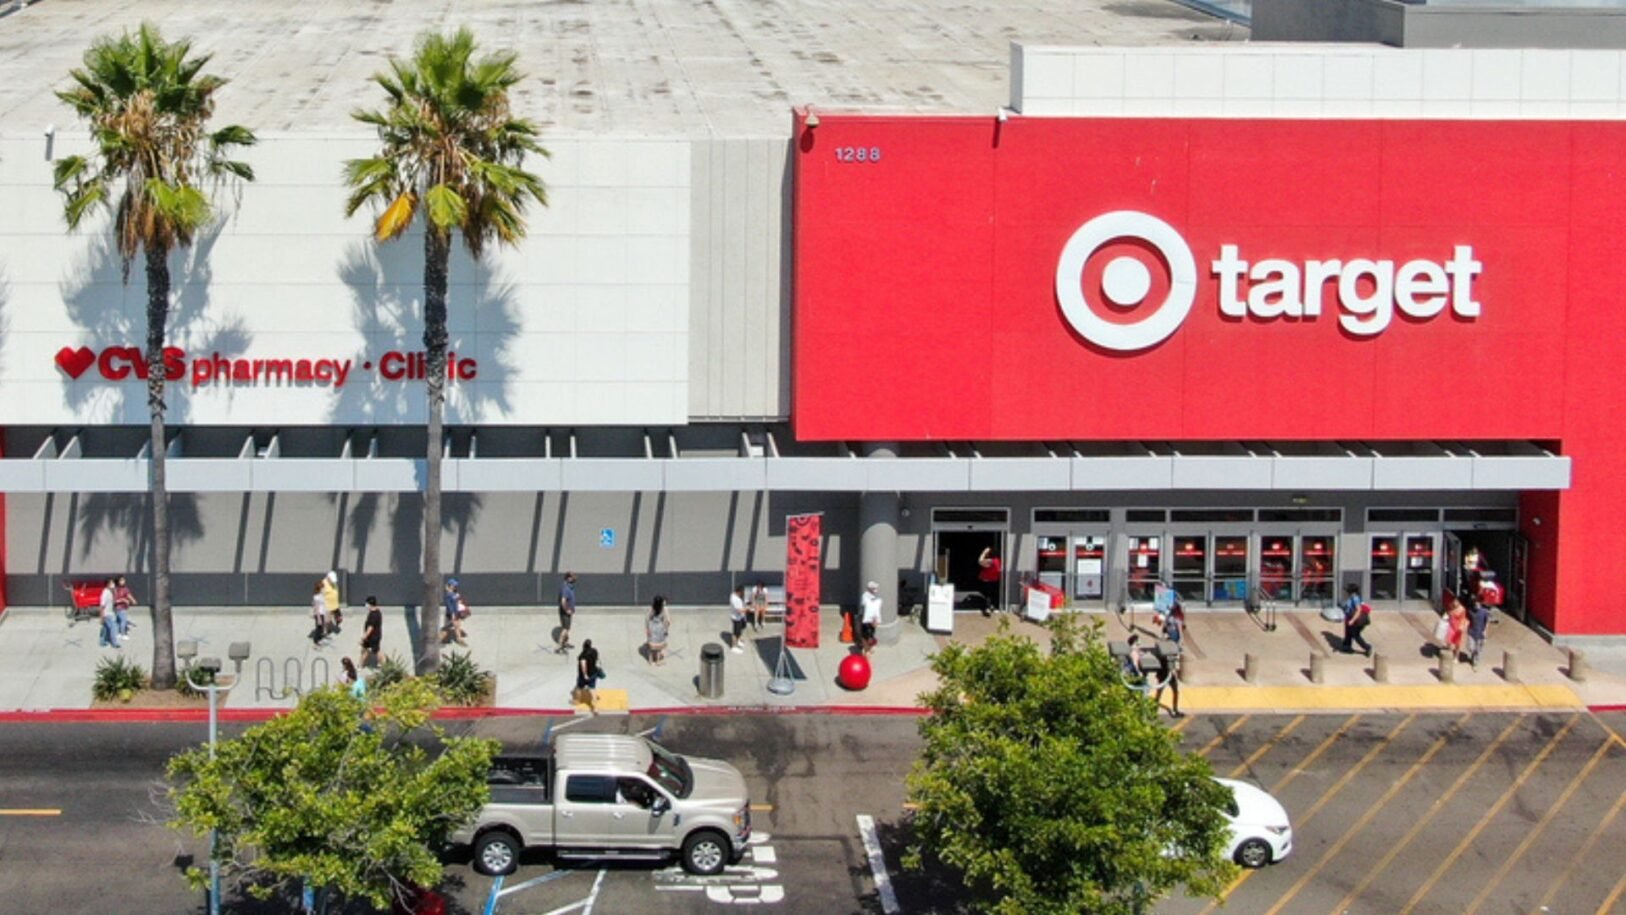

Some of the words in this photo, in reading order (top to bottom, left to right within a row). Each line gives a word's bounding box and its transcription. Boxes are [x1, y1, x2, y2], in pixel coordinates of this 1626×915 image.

[835, 146, 881, 161] 1288
[1212, 244, 1482, 336] target
[98, 345, 186, 381] CVS
[192, 351, 351, 387] pharmacy
[380, 351, 477, 381] Cliic
